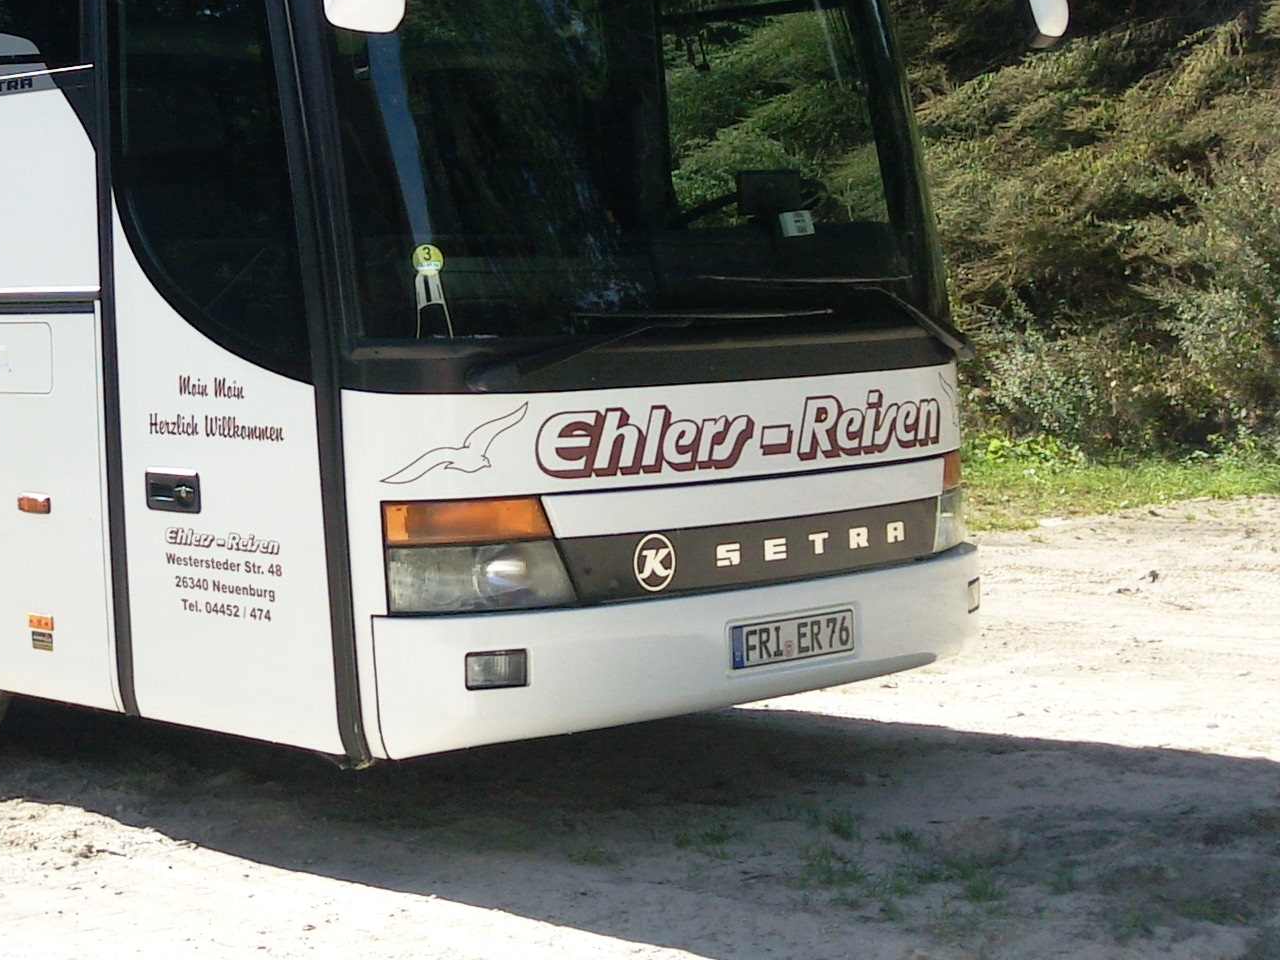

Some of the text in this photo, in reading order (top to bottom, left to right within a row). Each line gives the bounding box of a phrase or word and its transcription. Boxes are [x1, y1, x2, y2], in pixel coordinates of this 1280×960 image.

[422, 246, 432, 262] 3
[178, 375, 245, 400] Moin Moin
[149, 413, 284, 442] Herzlich Willkommen
[716, 521, 905, 567] SETRA
[166, 552, 283, 577] Westersteder Str. 48
[175, 575, 276, 602] 26340 Neuenburg
[181, 598, 202, 613] Tel.
[205, 601, 241, 618] 04452
[249, 607, 272, 621] 474
[745, 625, 783, 662] FRI
